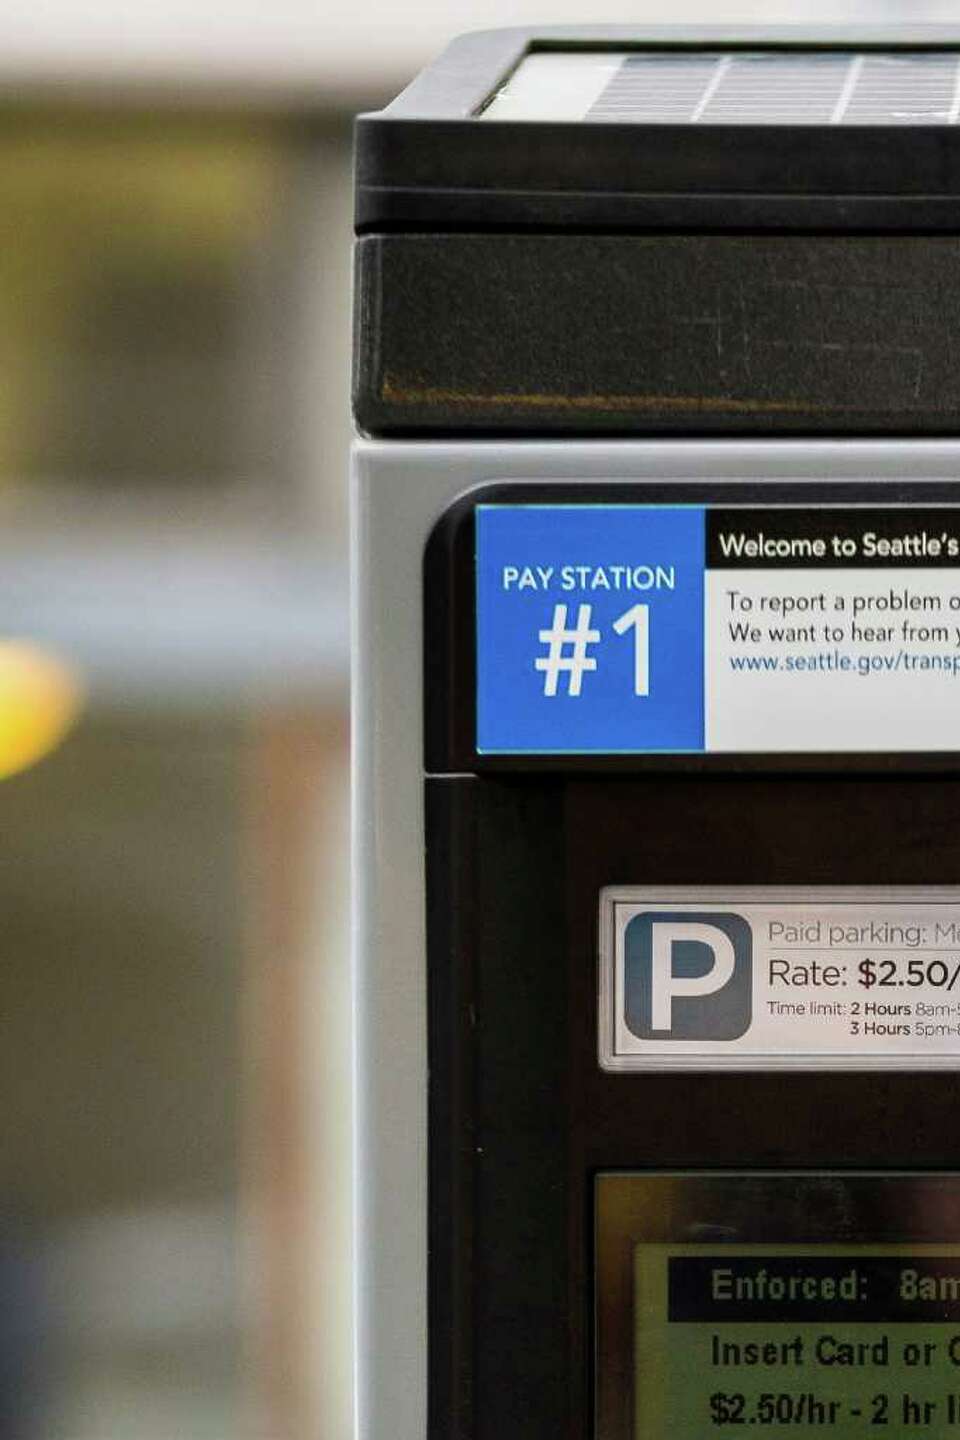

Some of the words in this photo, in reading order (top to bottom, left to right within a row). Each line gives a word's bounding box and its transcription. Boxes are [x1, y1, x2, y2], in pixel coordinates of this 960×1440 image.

[720, 533, 826, 556] Welcome
[832, 537, 856, 556] to
[863, 532, 958, 556] Seattle's
[504, 567, 553, 590] PAY
[562, 566, 674, 590] STATION
[728, 592, 752, 611] To
[761, 594, 825, 618] report
[834, 597, 844, 610] a
[853, 590, 940, 617] problem
[729, 623, 761, 642] We
[769, 625, 815, 642] want
[824, 625, 844, 642] to
[852, 621, 894, 641] hear
[902, 621, 948, 641] from
[535, 604, 649, 696] #1
[768, 920, 821, 944] Paid
[829, 921, 927, 948] parking:
[652, 923, 735, 1030] P
[770, 960, 846, 986] Rate:
[767, 1001, 806, 1015] Time
[808, 1002, 846, 1015] limit:
[850, 1002, 860, 1015] 2
[865, 1003, 911, 1015] Hours
[851, 1021, 859, 1035] 3
[865, 1022, 910, 1035] Hours
[712, 1269, 867, 1300] Enforced:
[713, 1336, 803, 1368] Insert
[816, 1336, 888, 1366] Card
[904, 1344, 936, 1366] or
[710, 1392, 841, 1426] $2.50/hr
[872, 1394, 888, 1424] 2
[903, 1392, 936, 1425] hr
